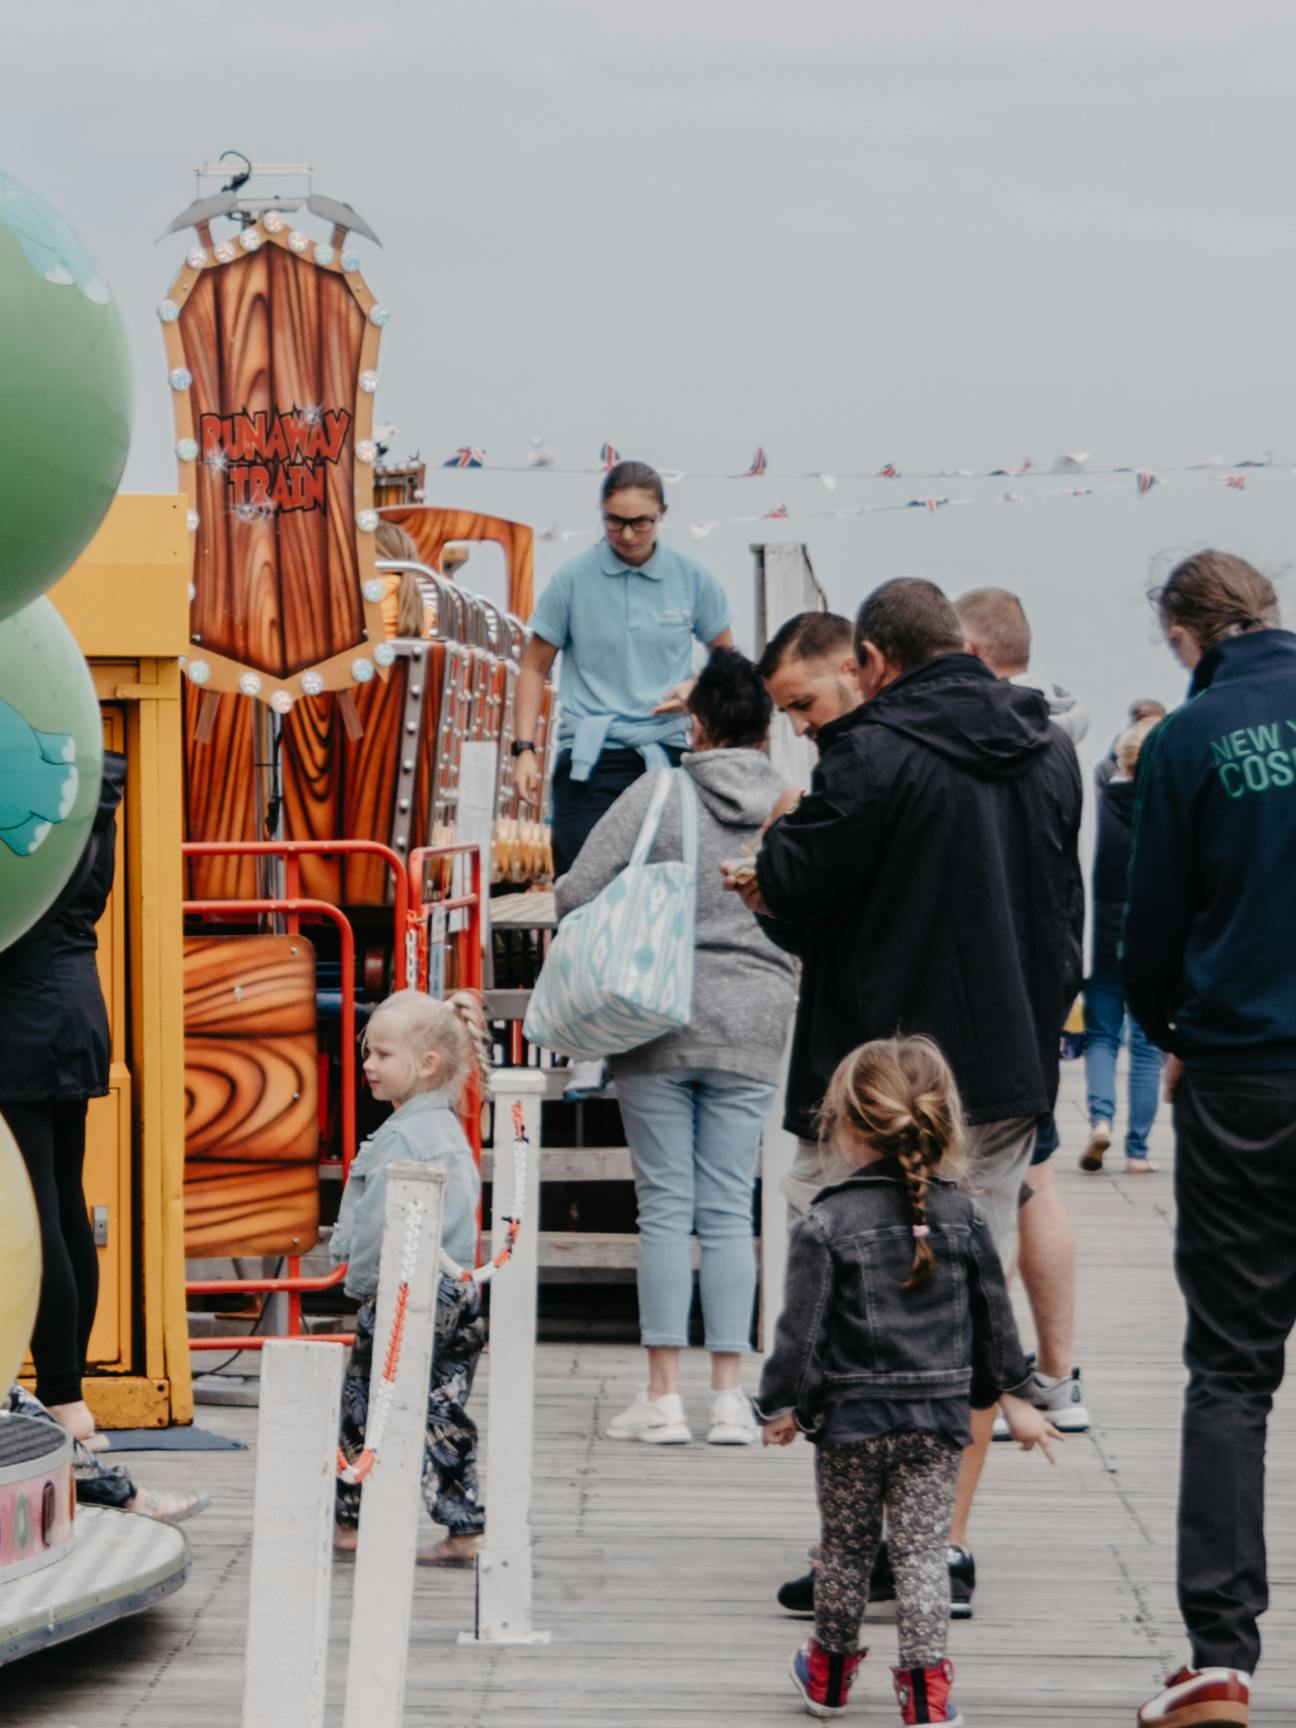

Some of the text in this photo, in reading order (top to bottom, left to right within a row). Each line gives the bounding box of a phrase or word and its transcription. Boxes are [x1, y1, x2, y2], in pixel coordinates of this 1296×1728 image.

[200, 403, 352, 465] RUNAWAY
[227, 461, 327, 517] TRAIN
[1209, 722, 1280, 765] NEW
[1218, 747, 1296, 798] COS
